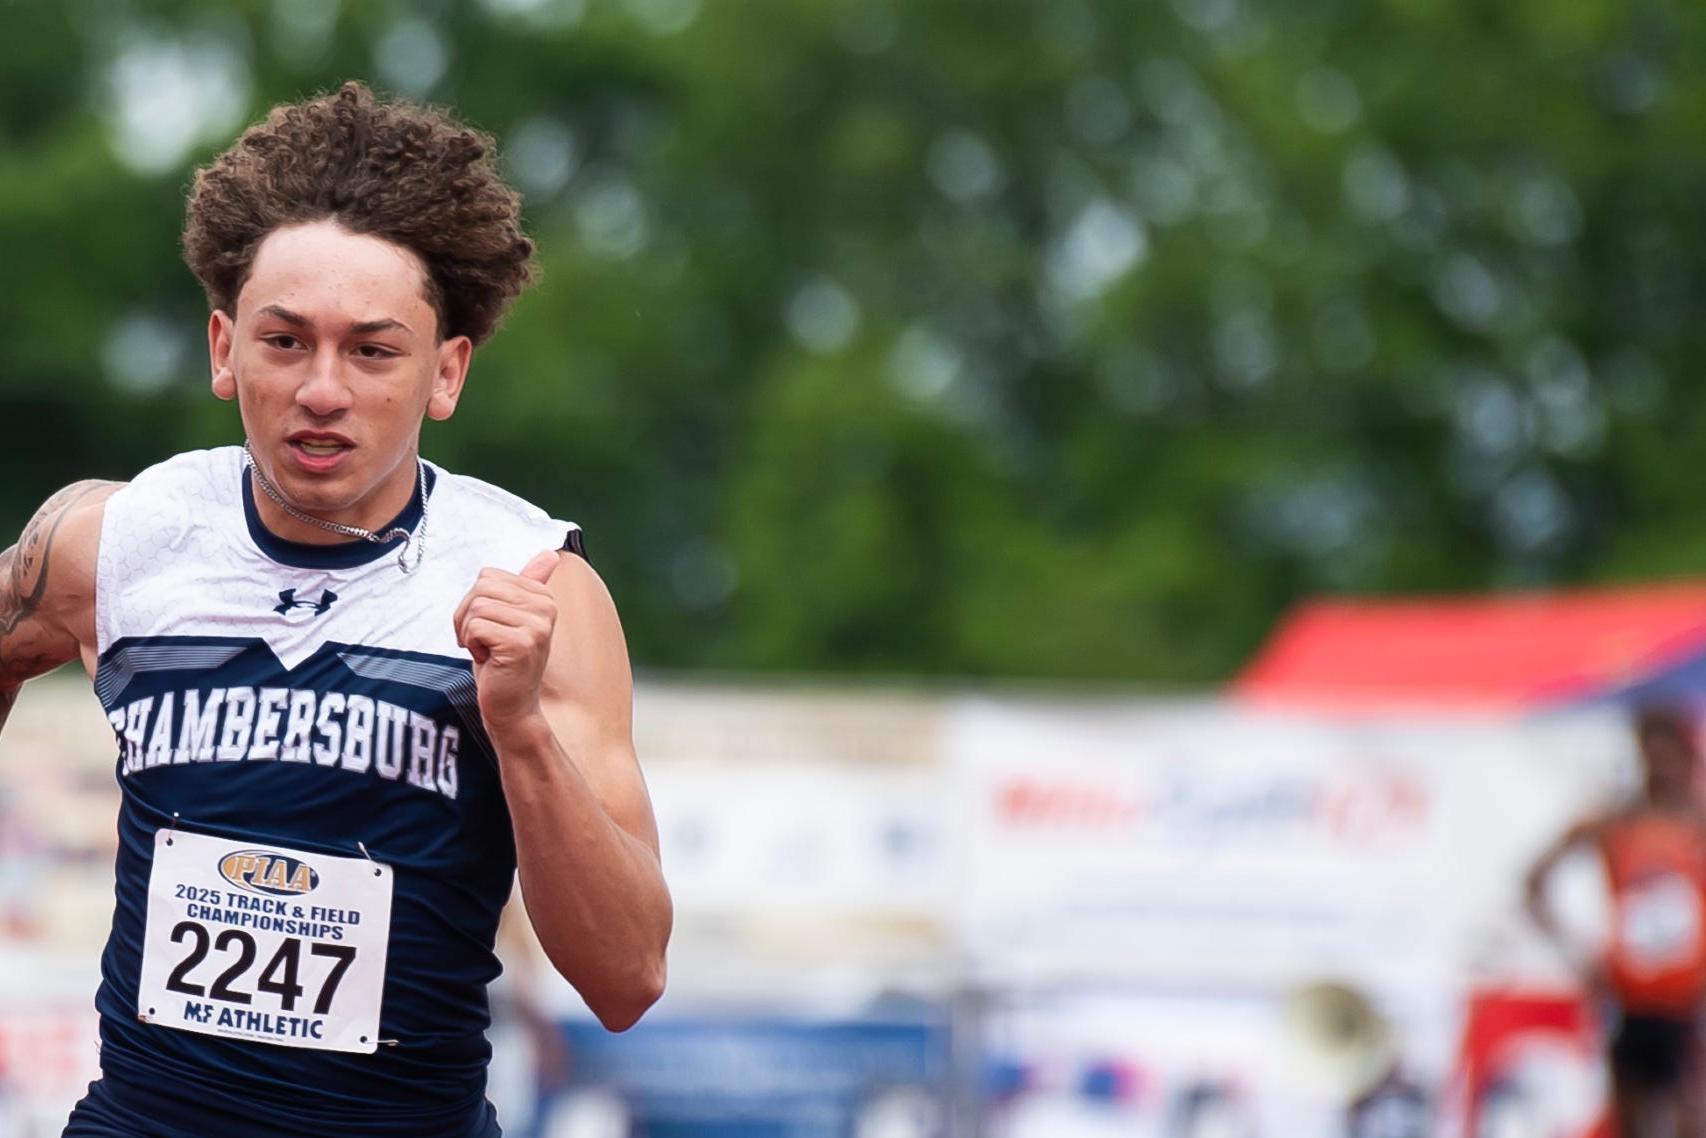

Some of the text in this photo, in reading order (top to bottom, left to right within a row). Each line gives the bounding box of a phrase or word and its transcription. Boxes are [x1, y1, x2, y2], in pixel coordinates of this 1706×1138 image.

[230, 855, 312, 892] PIAA
[174, 883, 361, 926] 2025 TRACK & FIELD
[187, 903, 343, 940] CHAMPIONSHIPS
[166, 921, 357, 1015] 2247
[184, 1001, 214, 1023] MF
[217, 1007, 323, 1039] ATHLETIC
